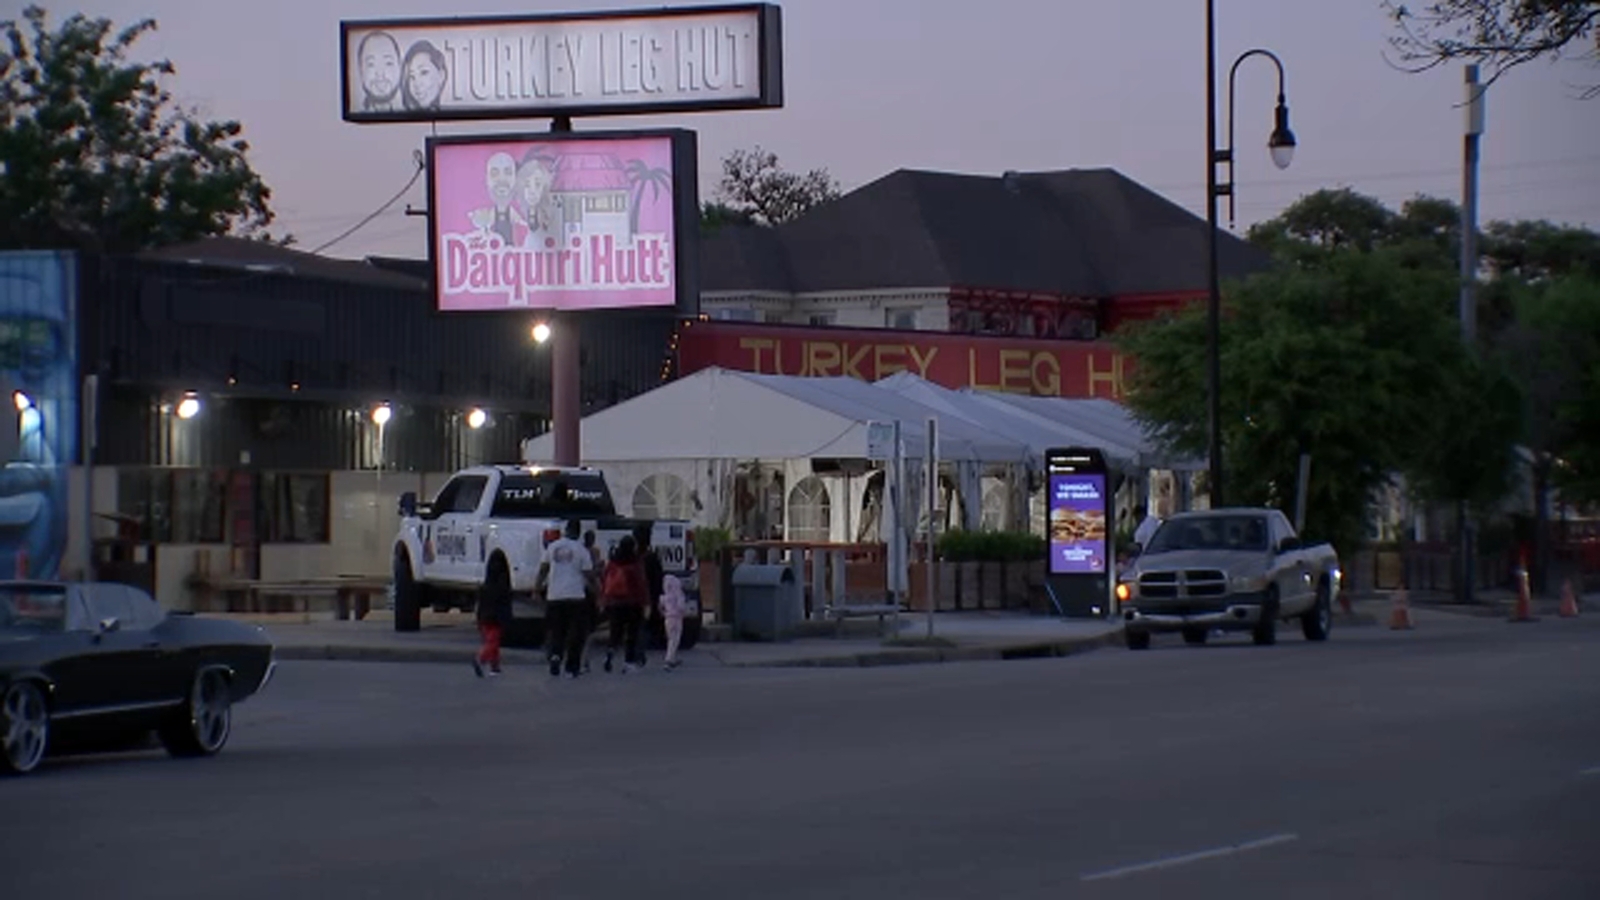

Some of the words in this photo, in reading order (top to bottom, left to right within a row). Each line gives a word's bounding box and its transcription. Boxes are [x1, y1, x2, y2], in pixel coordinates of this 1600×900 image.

[445, 34, 582, 100] TURKEY
[599, 31, 663, 95] LEG
[674, 26, 750, 91] HUT
[447, 237, 582, 300] Daiquiri
[590, 234, 664, 284] Hutt
[739, 337, 938, 383] TURKEY
[969, 347, 1061, 397] LEG
[1088, 352, 1138, 400] HU
